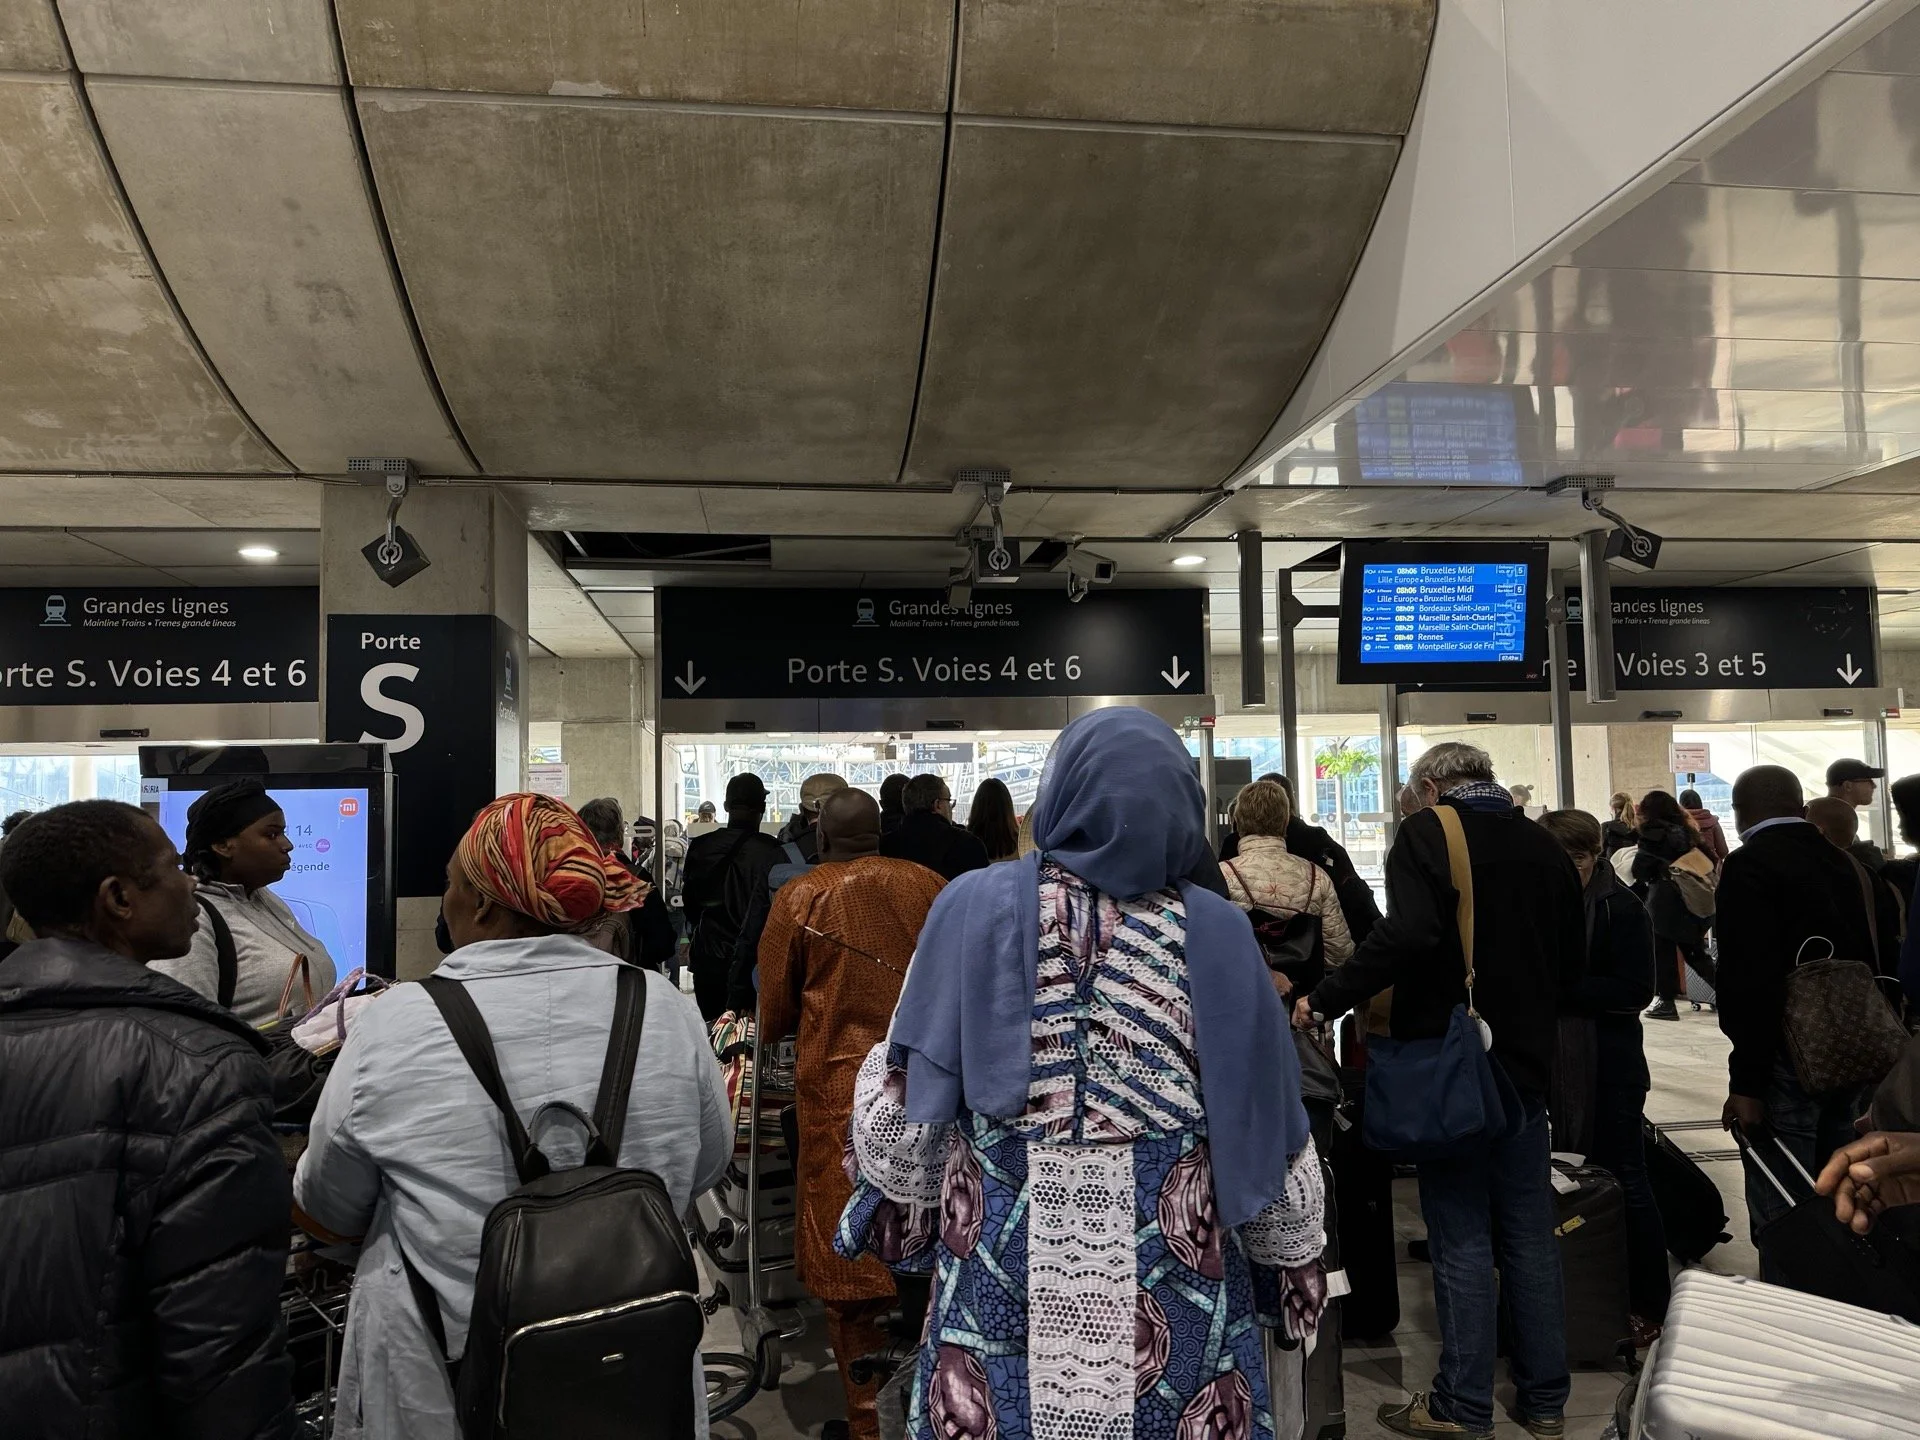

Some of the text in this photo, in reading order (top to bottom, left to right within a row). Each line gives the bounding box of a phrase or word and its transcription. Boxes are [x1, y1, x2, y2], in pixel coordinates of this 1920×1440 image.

[1420, 566, 1457, 575] Bruxelles
[1457, 566, 1475, 575] Midi
[1517, 566, 1523, 574] 5
[1378, 575, 1473, 585] Lille Europe Bruxelles Midi
[1420, 585, 1456, 594] Bruxelles
[1456, 585, 1474, 593] Midi
[1517, 585, 1522, 593] 5
[1377, 594, 1472, 604] Lille Europe Bruxelles Midi
[83, 597, 229, 618] Grandes lignes
[889, 600, 959, 615] Grandes
[1419, 604, 1452, 612] Bordeaux
[1453, 604, 1490, 612] Saint-Jean
[1612, 599, 1704, 617] andes lignes
[1418, 614, 1450, 622] Marseille
[83, 618, 120, 627] Mainline
[121, 618, 146, 627] Trains
[154, 618, 181, 627] Trenes
[181, 618, 211, 629] grande
[889, 619, 921, 628] Mainline
[922, 619, 943, 628] Trains
[950, 619, 973, 628] Trenes
[973, 619, 999, 629] grande
[1418, 623, 1450, 631] Marseille
[361, 632, 421, 650] Porte
[1418, 633, 1444, 641] Rennes
[1417, 643, 1458, 652] Montpellier
[1459, 642, 1473, 650] Sud
[1473, 642, 1483, 650] de
[788, 655, 1082, 683] Porte S. Voies 4 et 6
[1616, 652, 1767, 676] Voies 3 et 5
[0, 659, 307, 688] rte S. Voies 4 et 6
[359, 662, 425, 754] S
[296, 824, 313, 837] 14
[291, 861, 330, 874] égende
